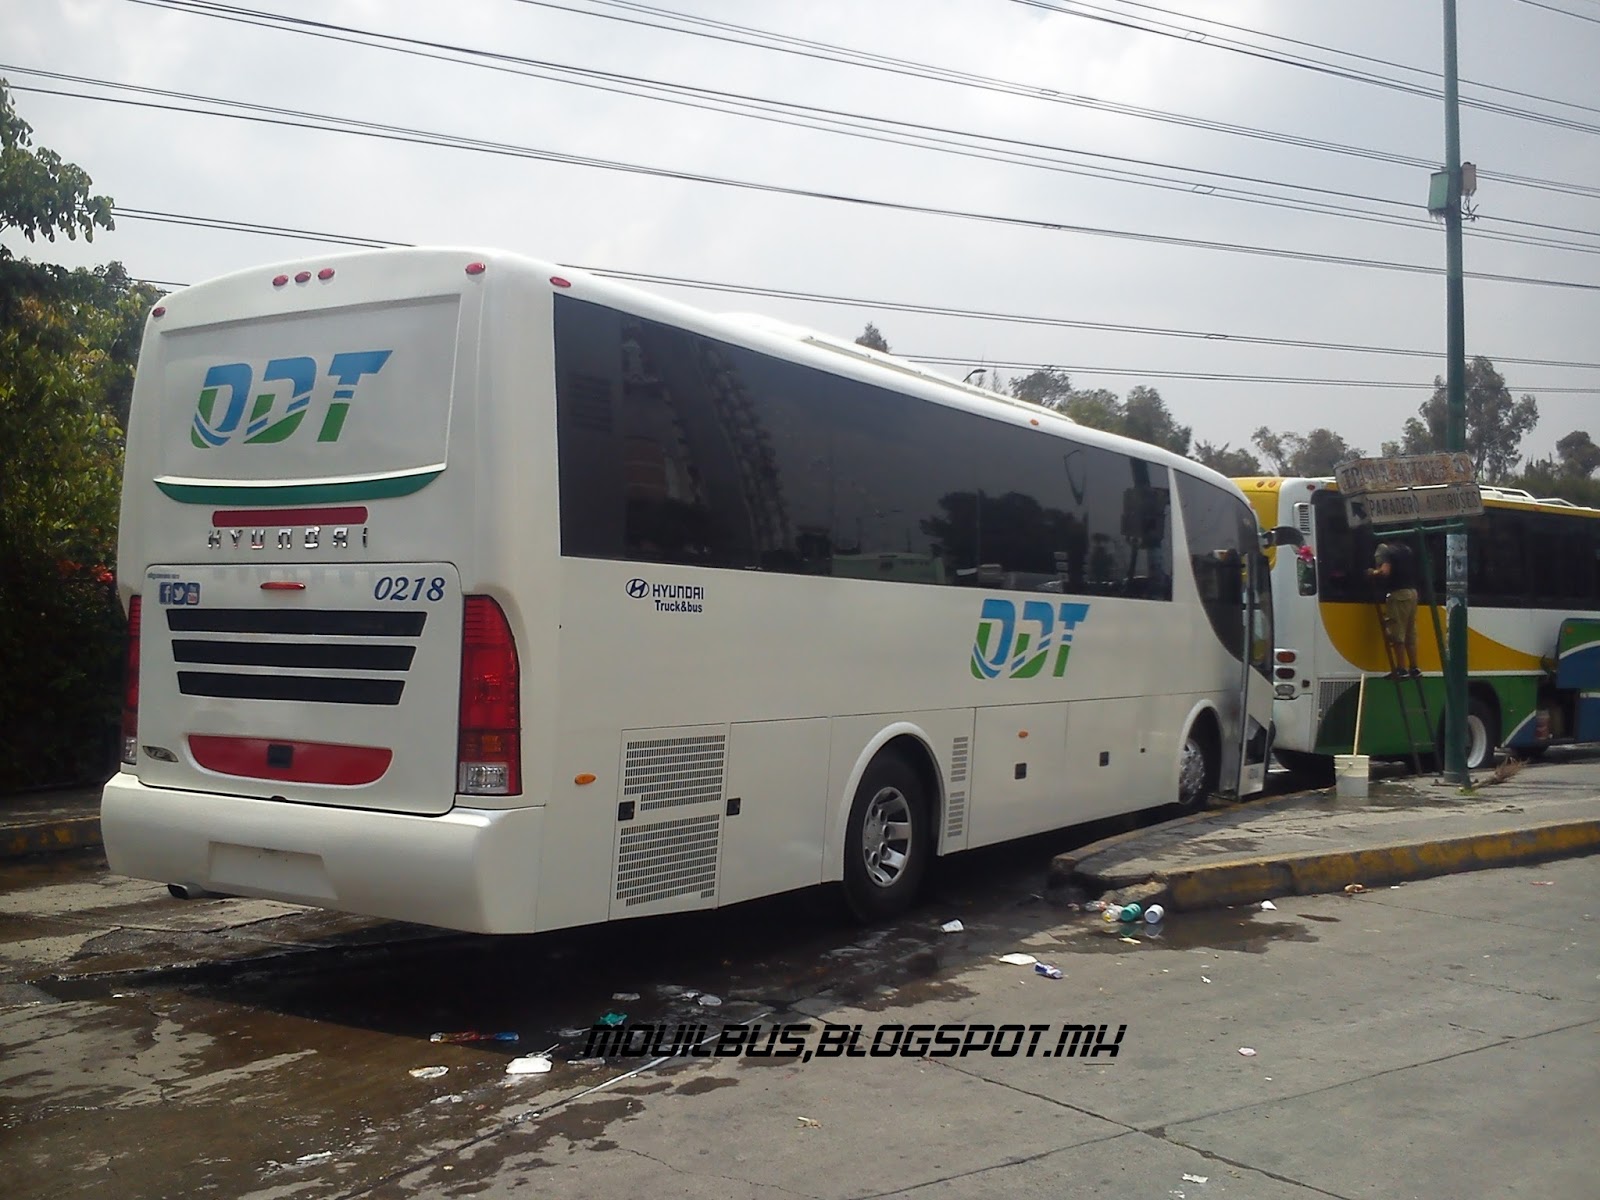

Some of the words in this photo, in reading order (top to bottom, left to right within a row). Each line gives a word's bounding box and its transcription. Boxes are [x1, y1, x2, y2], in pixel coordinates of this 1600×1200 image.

[207, 526, 369, 550] HYUNDAI
[373, 576, 446, 602] 0218
[652, 584, 704, 600] HYUNDAI
[654, 600, 703, 613] Truck&bus
